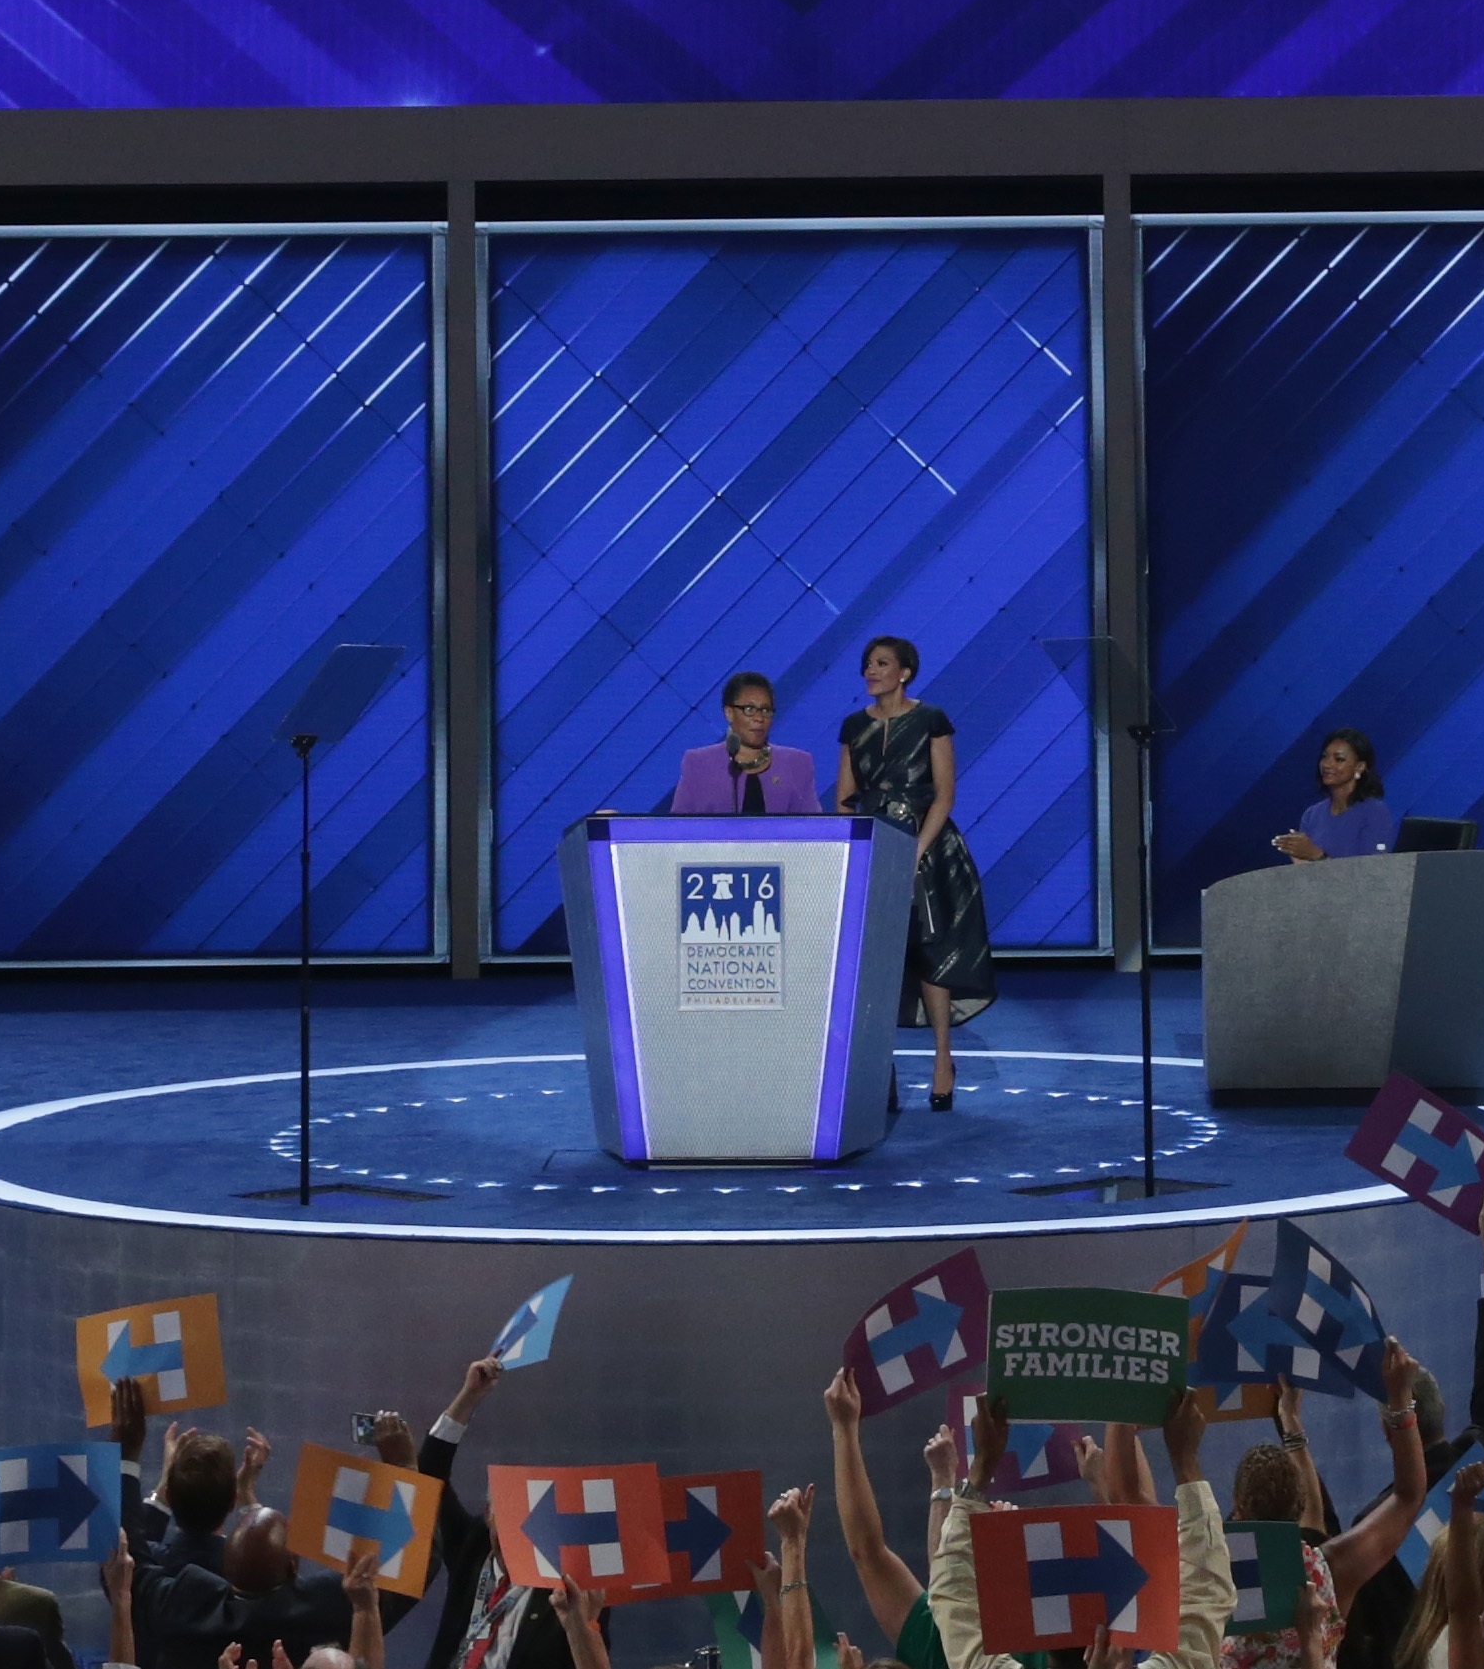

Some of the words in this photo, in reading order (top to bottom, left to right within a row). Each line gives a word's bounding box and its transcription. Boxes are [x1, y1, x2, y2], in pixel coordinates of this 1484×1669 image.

[686, 945, 776, 958] DEMOCRATIC
[687, 961, 776, 975] NATIONAL
[687, 978, 776, 991] CONVENTION
[686, 996, 776, 1005] PHILADELPHIA
[995, 1322, 1181, 1358] STRONGER
[1003, 1351, 1170, 1385] FAMILIES
